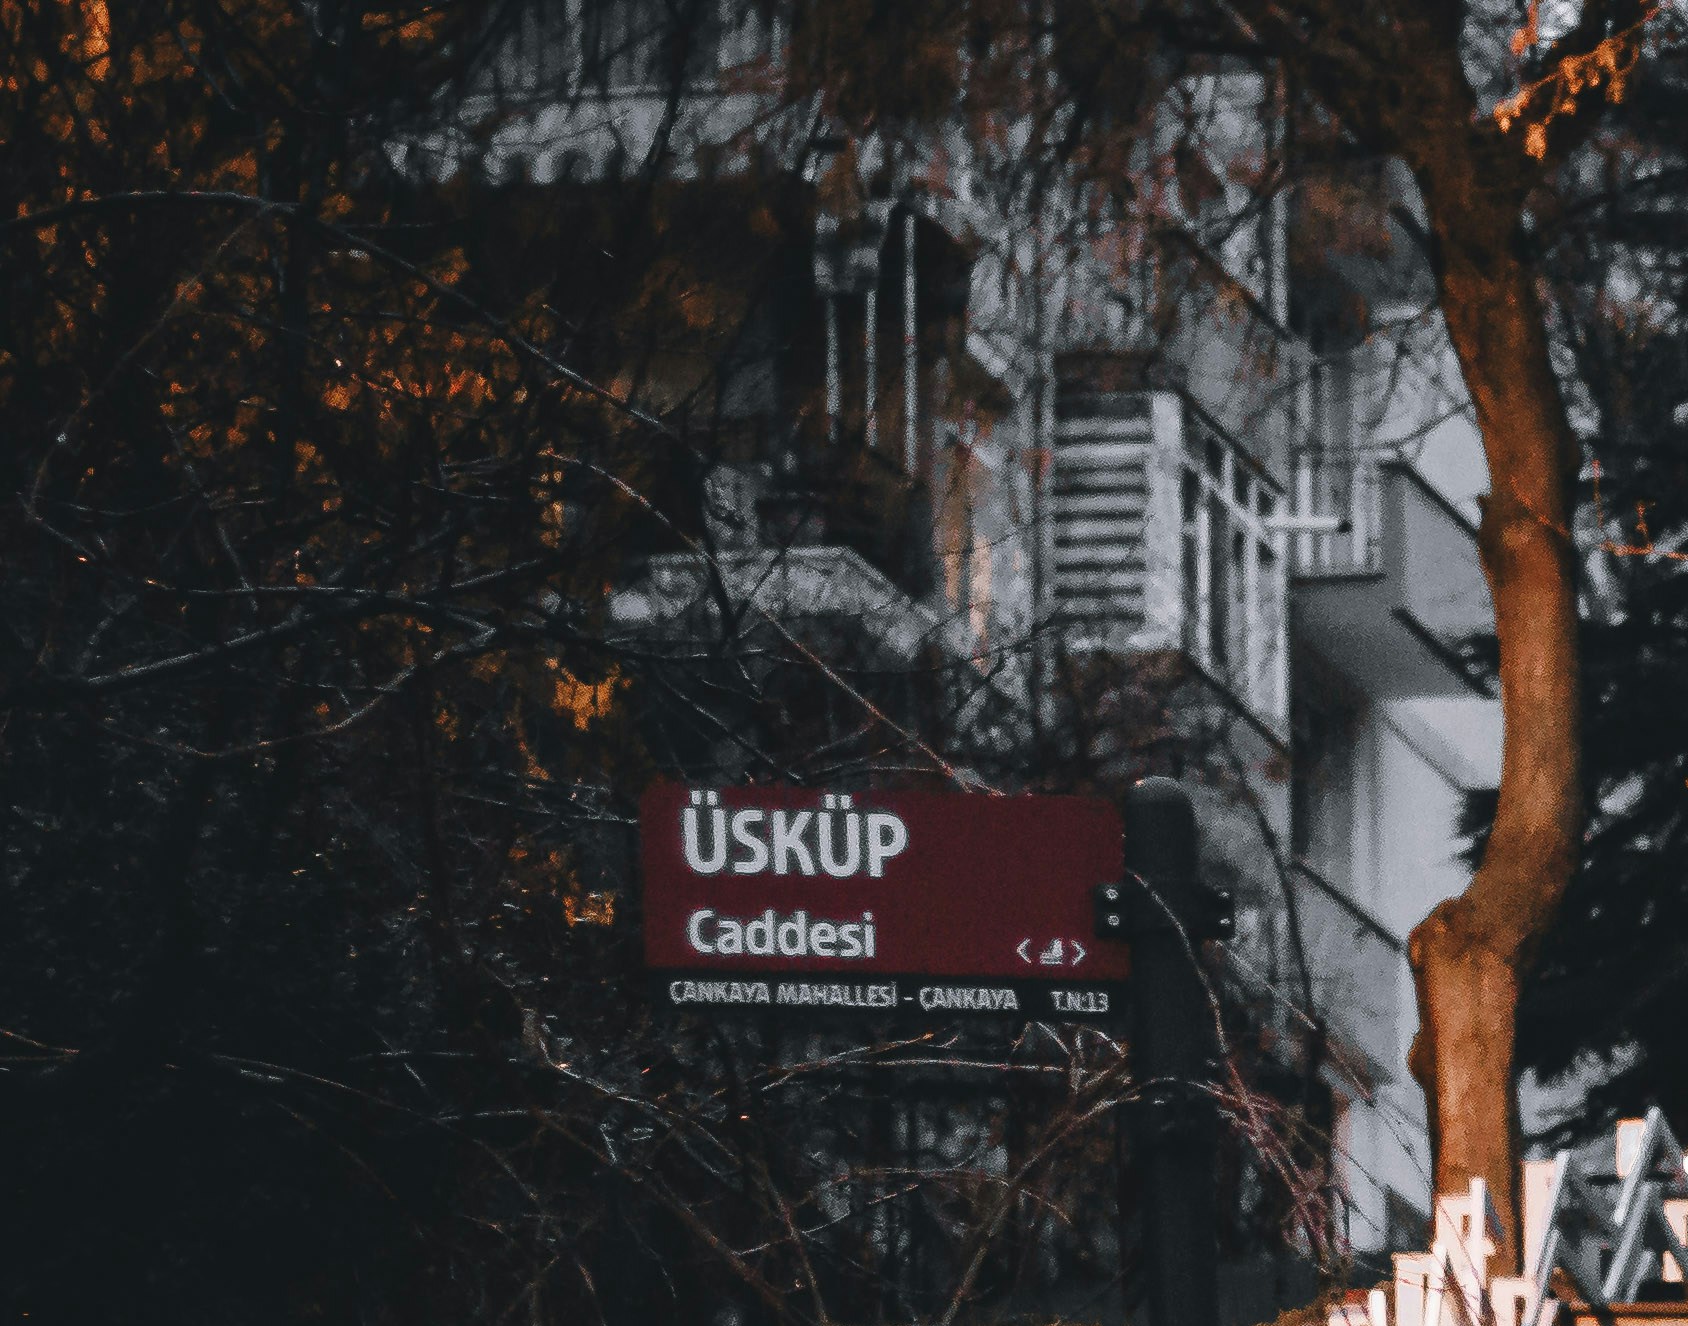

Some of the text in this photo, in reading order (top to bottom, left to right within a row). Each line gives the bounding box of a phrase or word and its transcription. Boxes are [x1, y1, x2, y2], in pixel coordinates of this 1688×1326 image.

[683, 790, 907, 878] ÜSKÜP
[688, 909, 876, 957] Caddesi
[670, 981, 770, 1004] ÇANKAYA
[776, 981, 897, 1007] MAHALLESİ
[917, 987, 1019, 1011] ÇANKAYA
